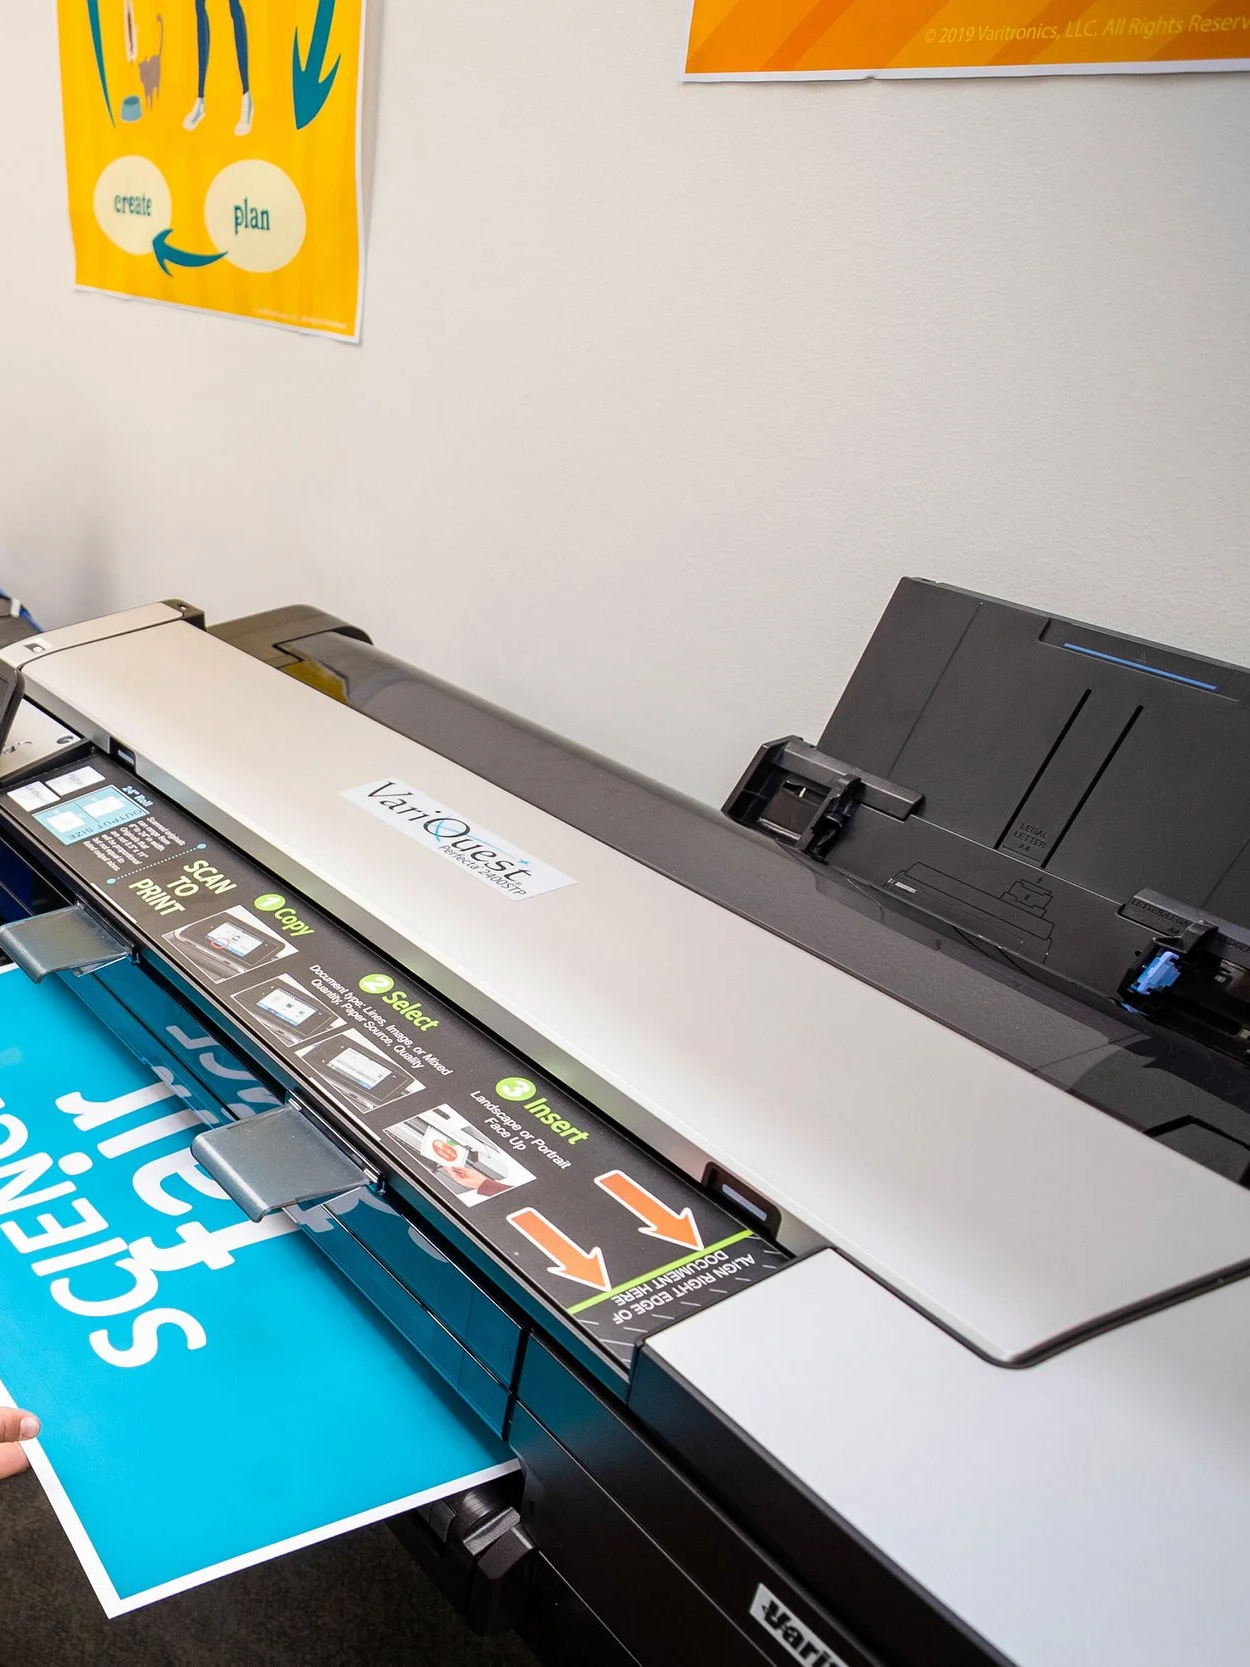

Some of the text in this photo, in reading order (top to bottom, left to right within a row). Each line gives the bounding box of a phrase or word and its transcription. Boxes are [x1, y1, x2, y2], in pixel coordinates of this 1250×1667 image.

[938, 27, 975, 43] 2019
[978, 23, 1061, 41] Varitronics,
[1065, 20, 1098, 37] LLC.
[1102, 17, 1125, 36] All
[1129, 16, 1184, 39] Rights
[1187, 14, 1250, 33] Reserv
[114, 193, 152, 217] create
[233, 197, 271, 235] plan
[68, 808, 143, 840] OUTPUT SIZE
[367, 781, 532, 882] VariQuest
[1013, 830, 1046, 849] LETTER
[1020, 823, 1047, 840] LEGAL
[166, 875, 199, 897] TO
[183, 860, 238, 896] SCAN
[438, 845, 527, 898] Perfecta 2400STP
[128, 878, 187, 917] PRINT
[1131, 899, 1193, 927] LETTER/LEGA
[273, 908, 316, 937] Copy
[310, 965, 454, 1076] Document type: Lines, Image, or Mixed
[363, 976, 440, 1031] 2 Select
[311, 979, 425, 1069] Quantity, Paper Source, Quality
[470, 1090, 572, 1170] Landscape or Portrait
[502, 1080, 590, 1145] 3 Insert
[484, 1117, 527, 1152] Face Up
[55, 1078, 303, 1271] fair
[611, 1249, 730, 1307] DOCUMENT HERE
[612, 1253, 756, 1325] ALIGN RIGHT EDGE OF
[761, 1599, 844, 1667] Vari
